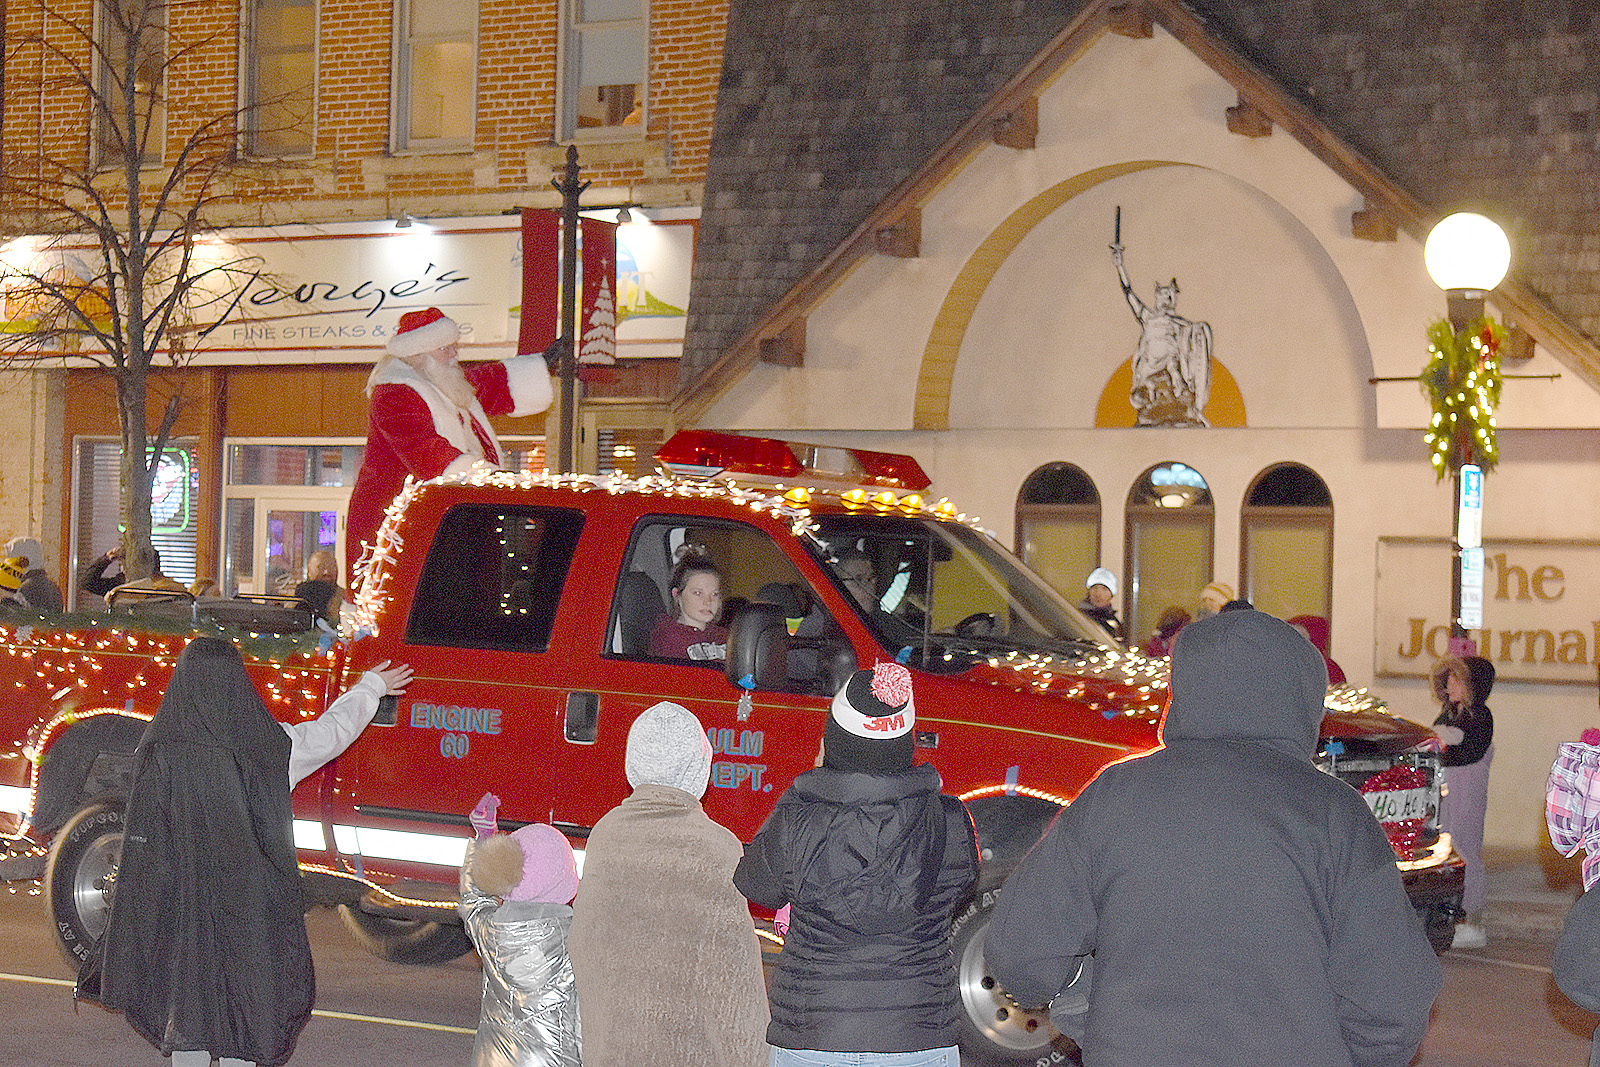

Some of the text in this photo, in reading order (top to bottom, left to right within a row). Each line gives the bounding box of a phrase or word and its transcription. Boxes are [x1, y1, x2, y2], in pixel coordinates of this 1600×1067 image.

[233, 328, 276, 341] FINE
[283, 325, 366, 339] STEAKS
[372, 324, 386, 337] &
[1484, 552, 1566, 602] he
[411, 702, 502, 734] ENGINE
[440, 732, 469, 759] 60
[707, 727, 764, 757] ULM
[711, 760, 773, 793] EPT.
